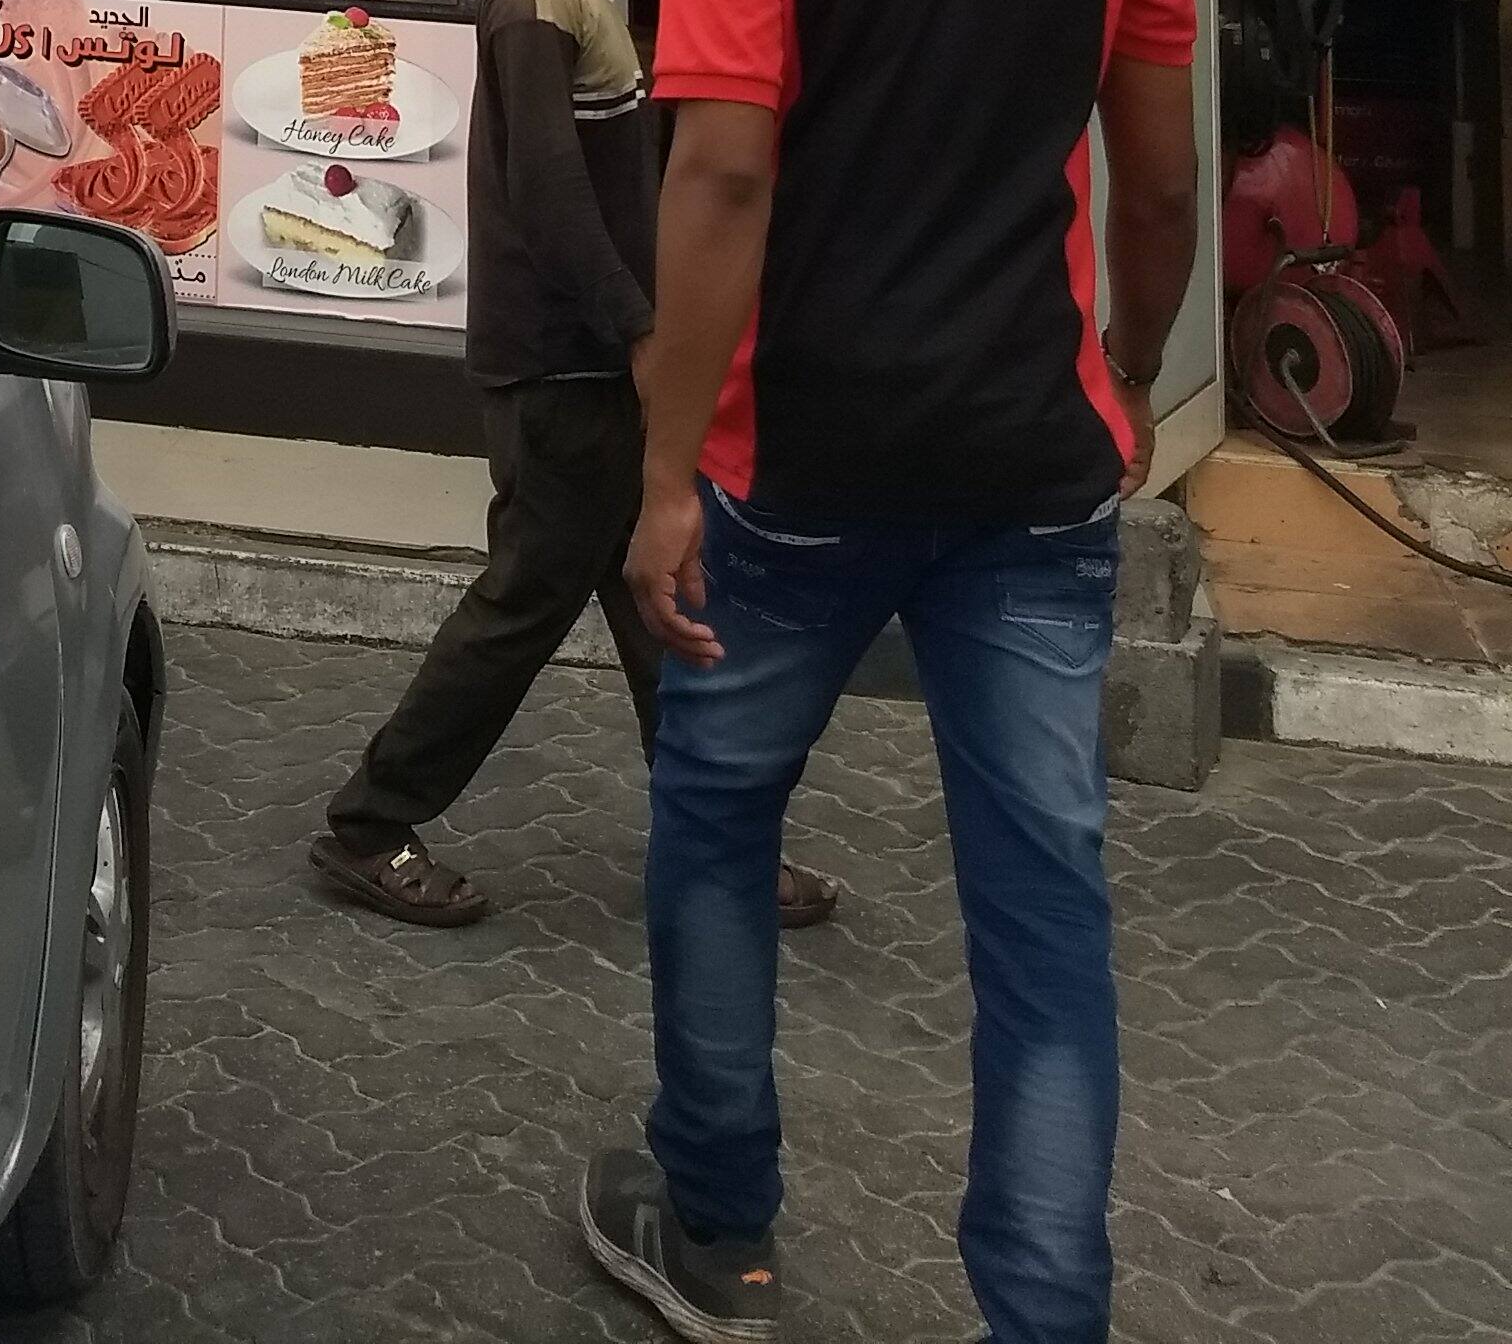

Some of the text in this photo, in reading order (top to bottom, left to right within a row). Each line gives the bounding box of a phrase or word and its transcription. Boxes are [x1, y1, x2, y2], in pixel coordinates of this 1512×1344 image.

[88, 5, 150, 30] الجديد
[56, 32, 186, 73] لوتس
[281, 119, 395, 154] Honey Cake
[266, 256, 432, 295] London Milk Cake
